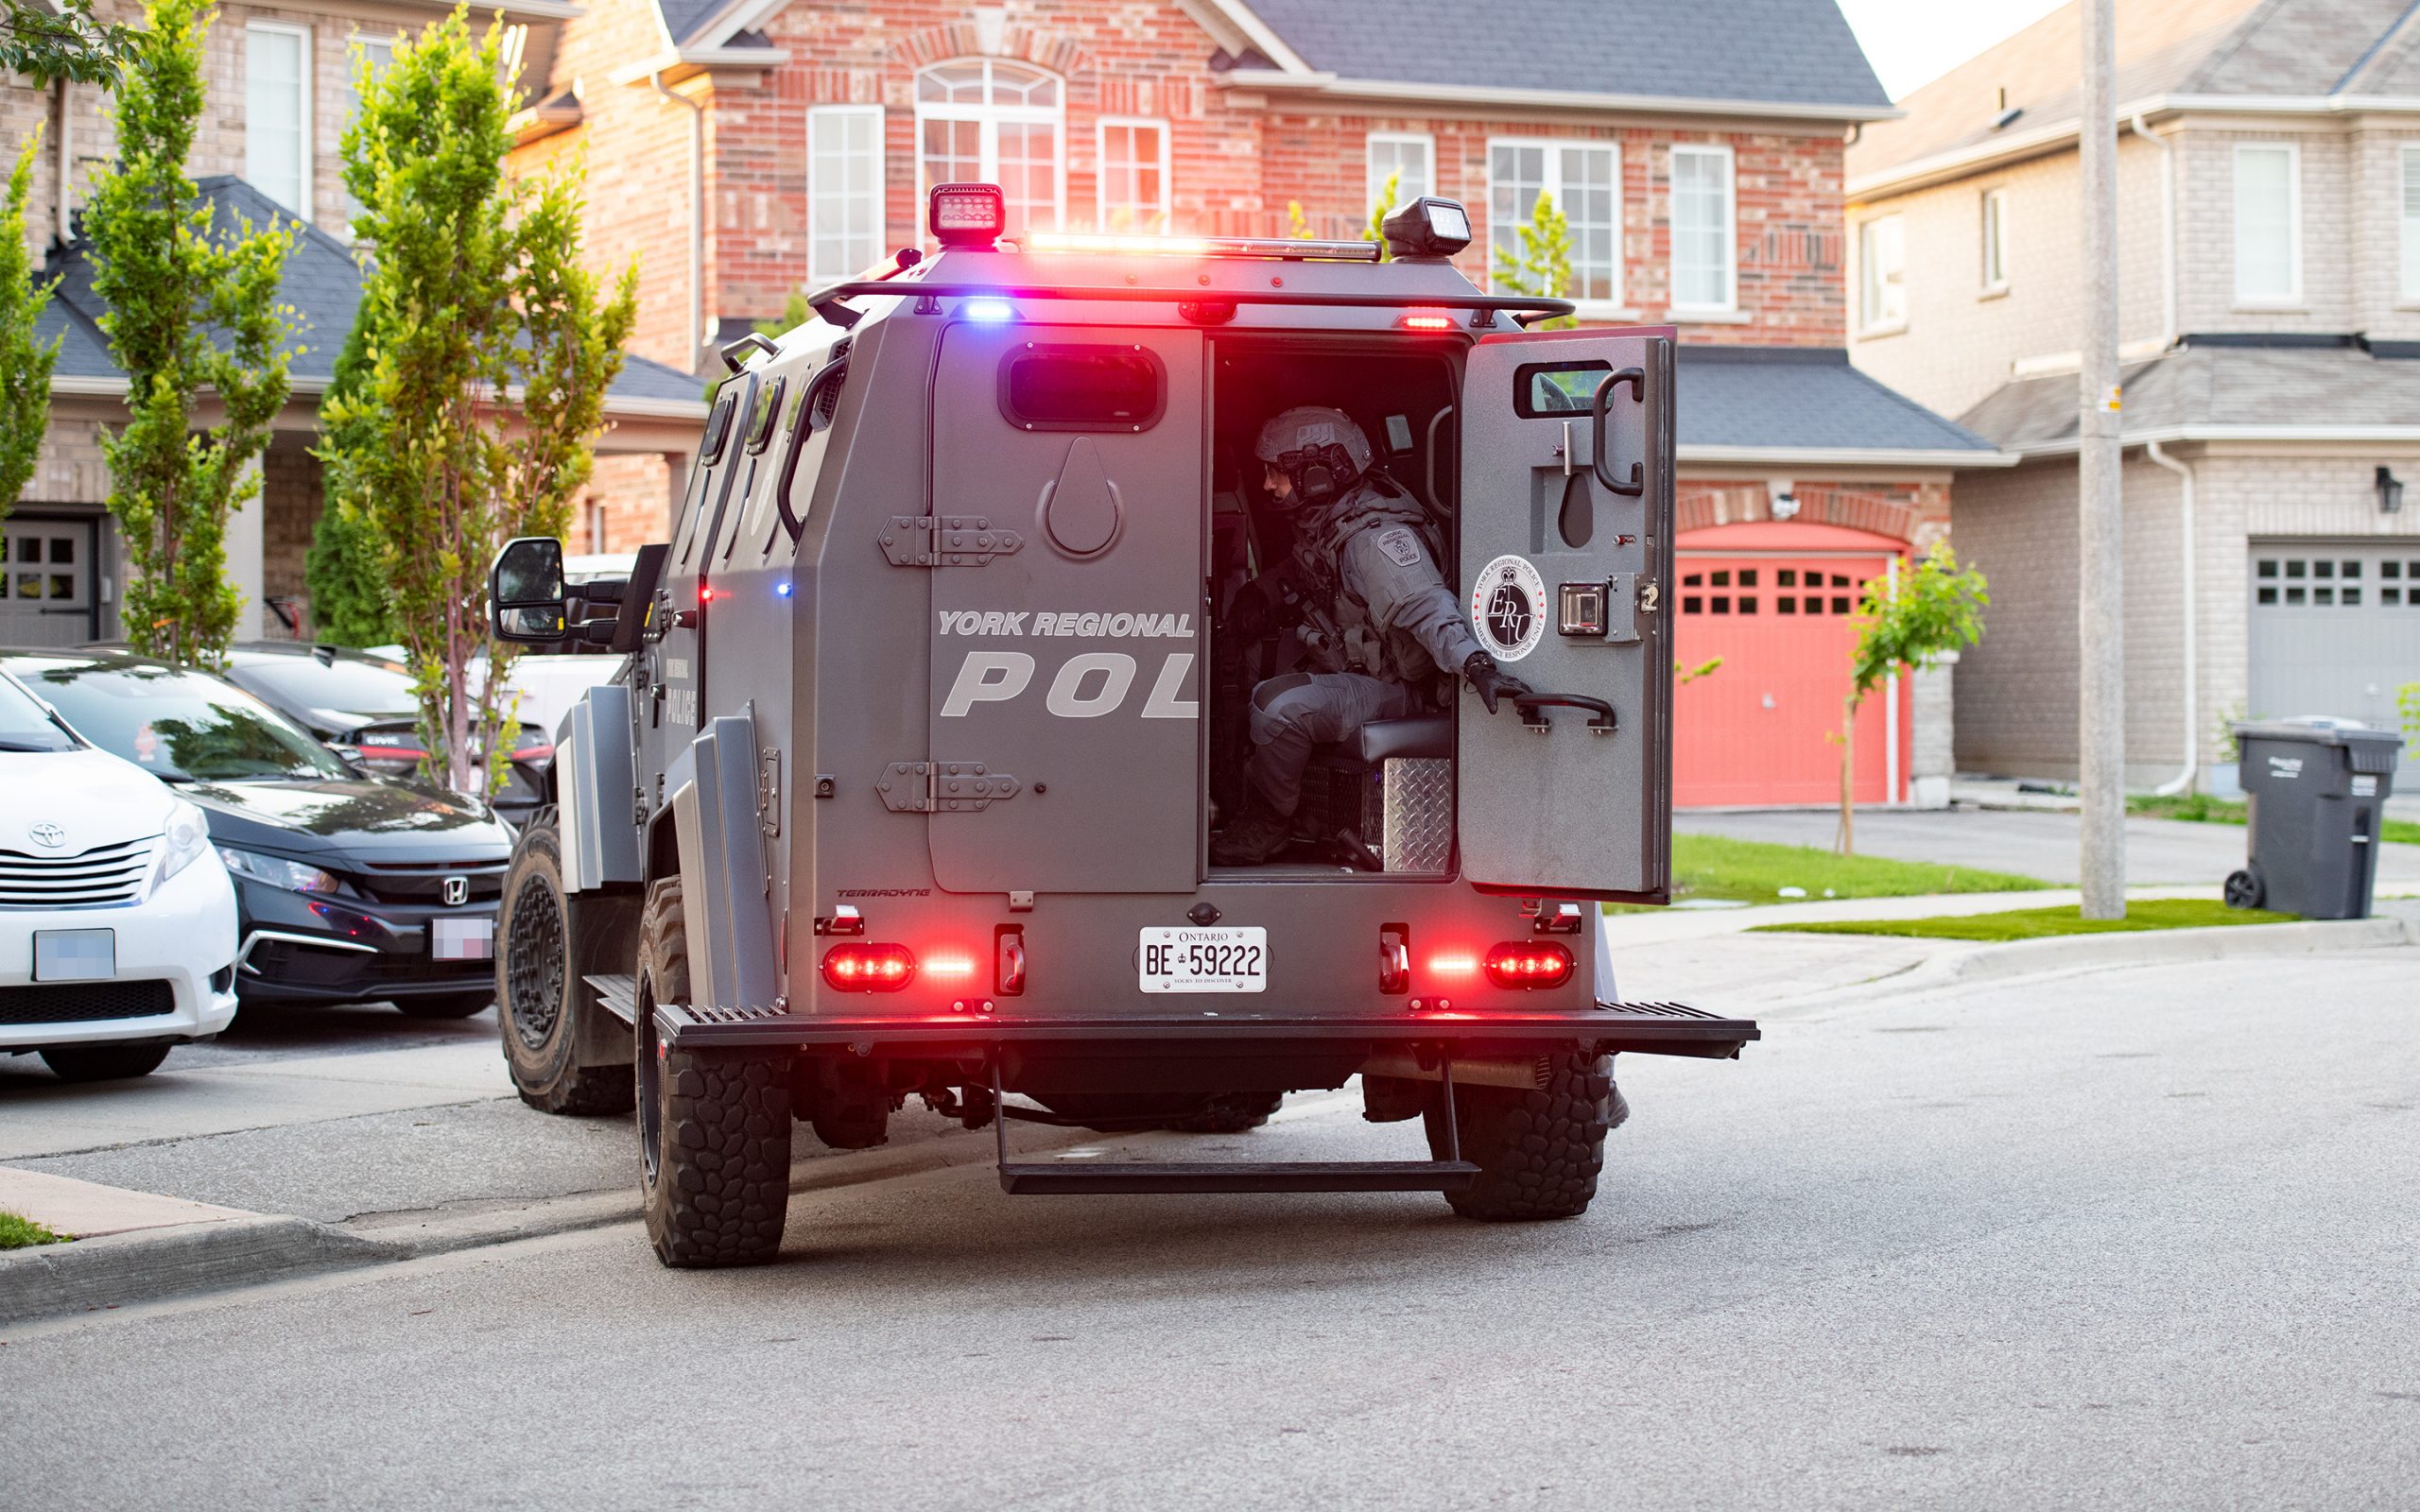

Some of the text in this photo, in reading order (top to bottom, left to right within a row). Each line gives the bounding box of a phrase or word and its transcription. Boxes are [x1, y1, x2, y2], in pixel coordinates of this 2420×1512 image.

[1399, 553, 1417, 563] POLICE
[1478, 558, 1539, 590] YORK REGIONAL POLICE
[939, 610, 1195, 637] YORK REGIONAL
[1531, 622, 1543, 642] UNIT
[940, 651, 1199, 718] POL
[666, 688, 697, 727] POLICE
[837, 888, 931, 898] TERRADYNE
[1179, 932, 1229, 942] ONTARIO
[1147, 945, 1260, 975] BE 59222
